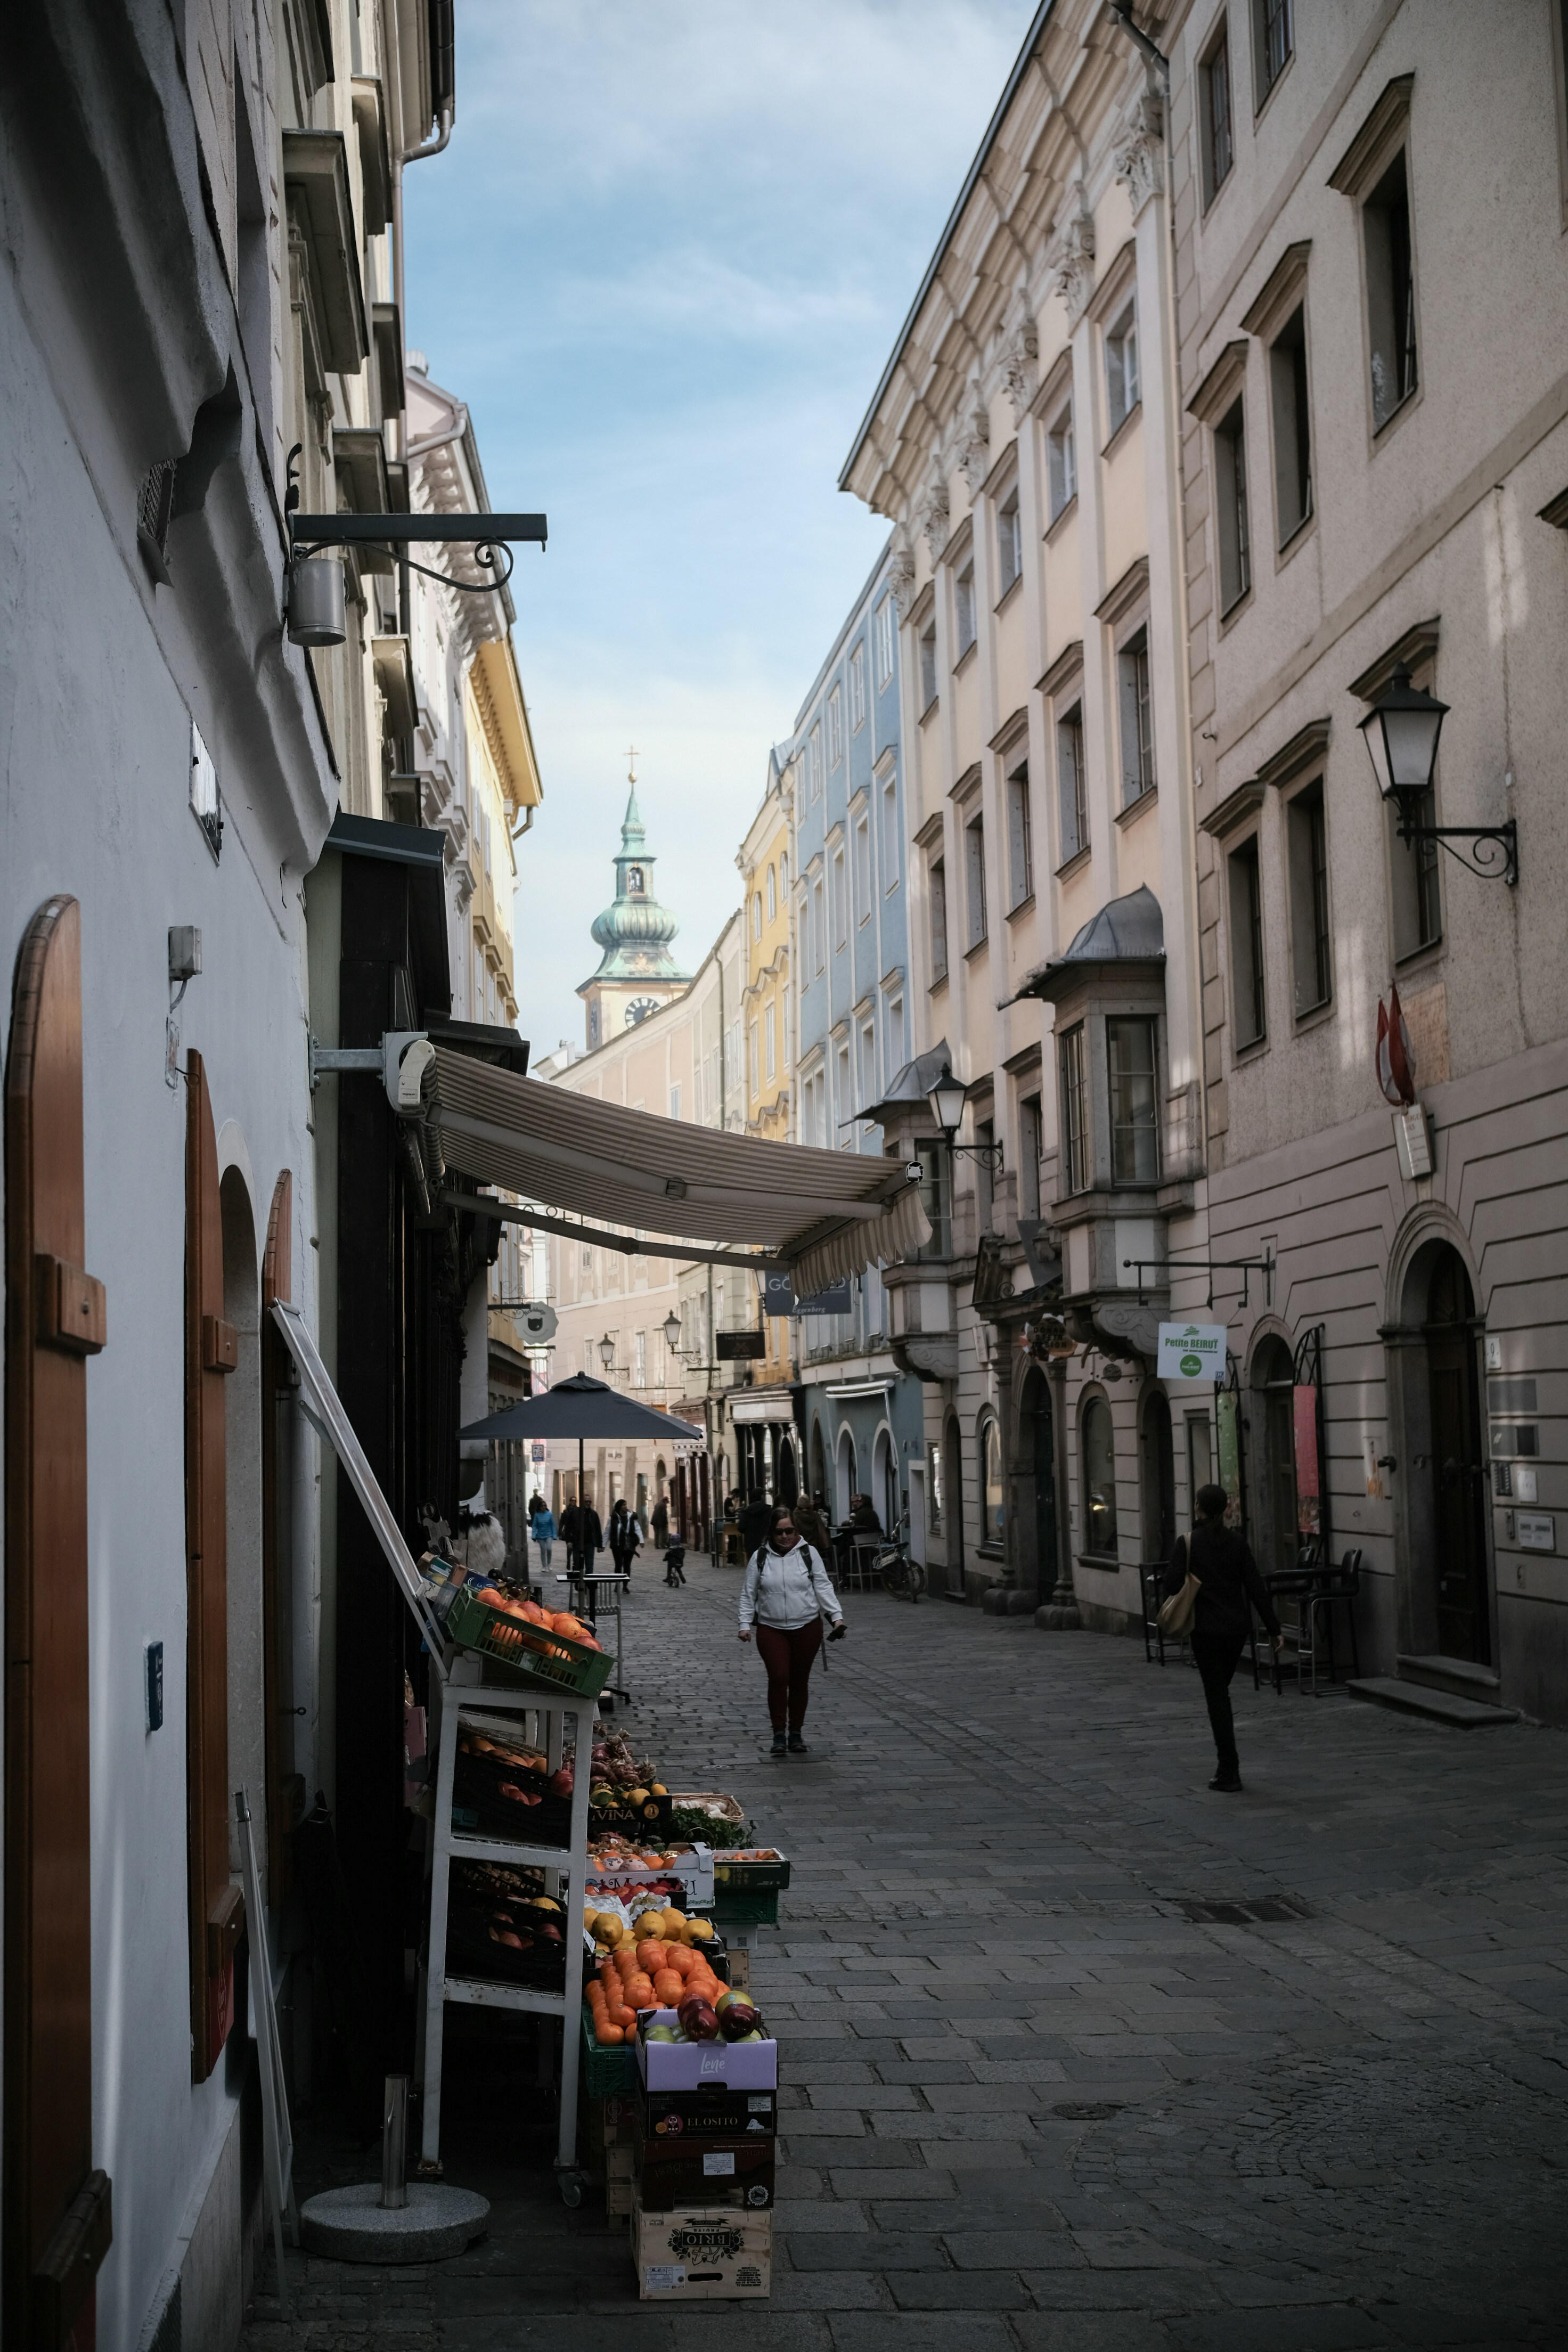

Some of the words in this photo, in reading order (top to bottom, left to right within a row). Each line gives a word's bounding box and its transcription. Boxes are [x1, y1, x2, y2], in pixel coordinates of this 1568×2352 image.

[792, 1306, 826, 1314] Eggenberg
[1165, 1338, 1189, 1348] Petite
[1190, 1339, 1218, 1349] BEIRUT
[1490, 1343, 1494, 1358] 9
[700, 2052, 725, 2075] Lene
[703, 2117, 738, 2126] OSITO
[686, 2234, 725, 2244] BRIO
